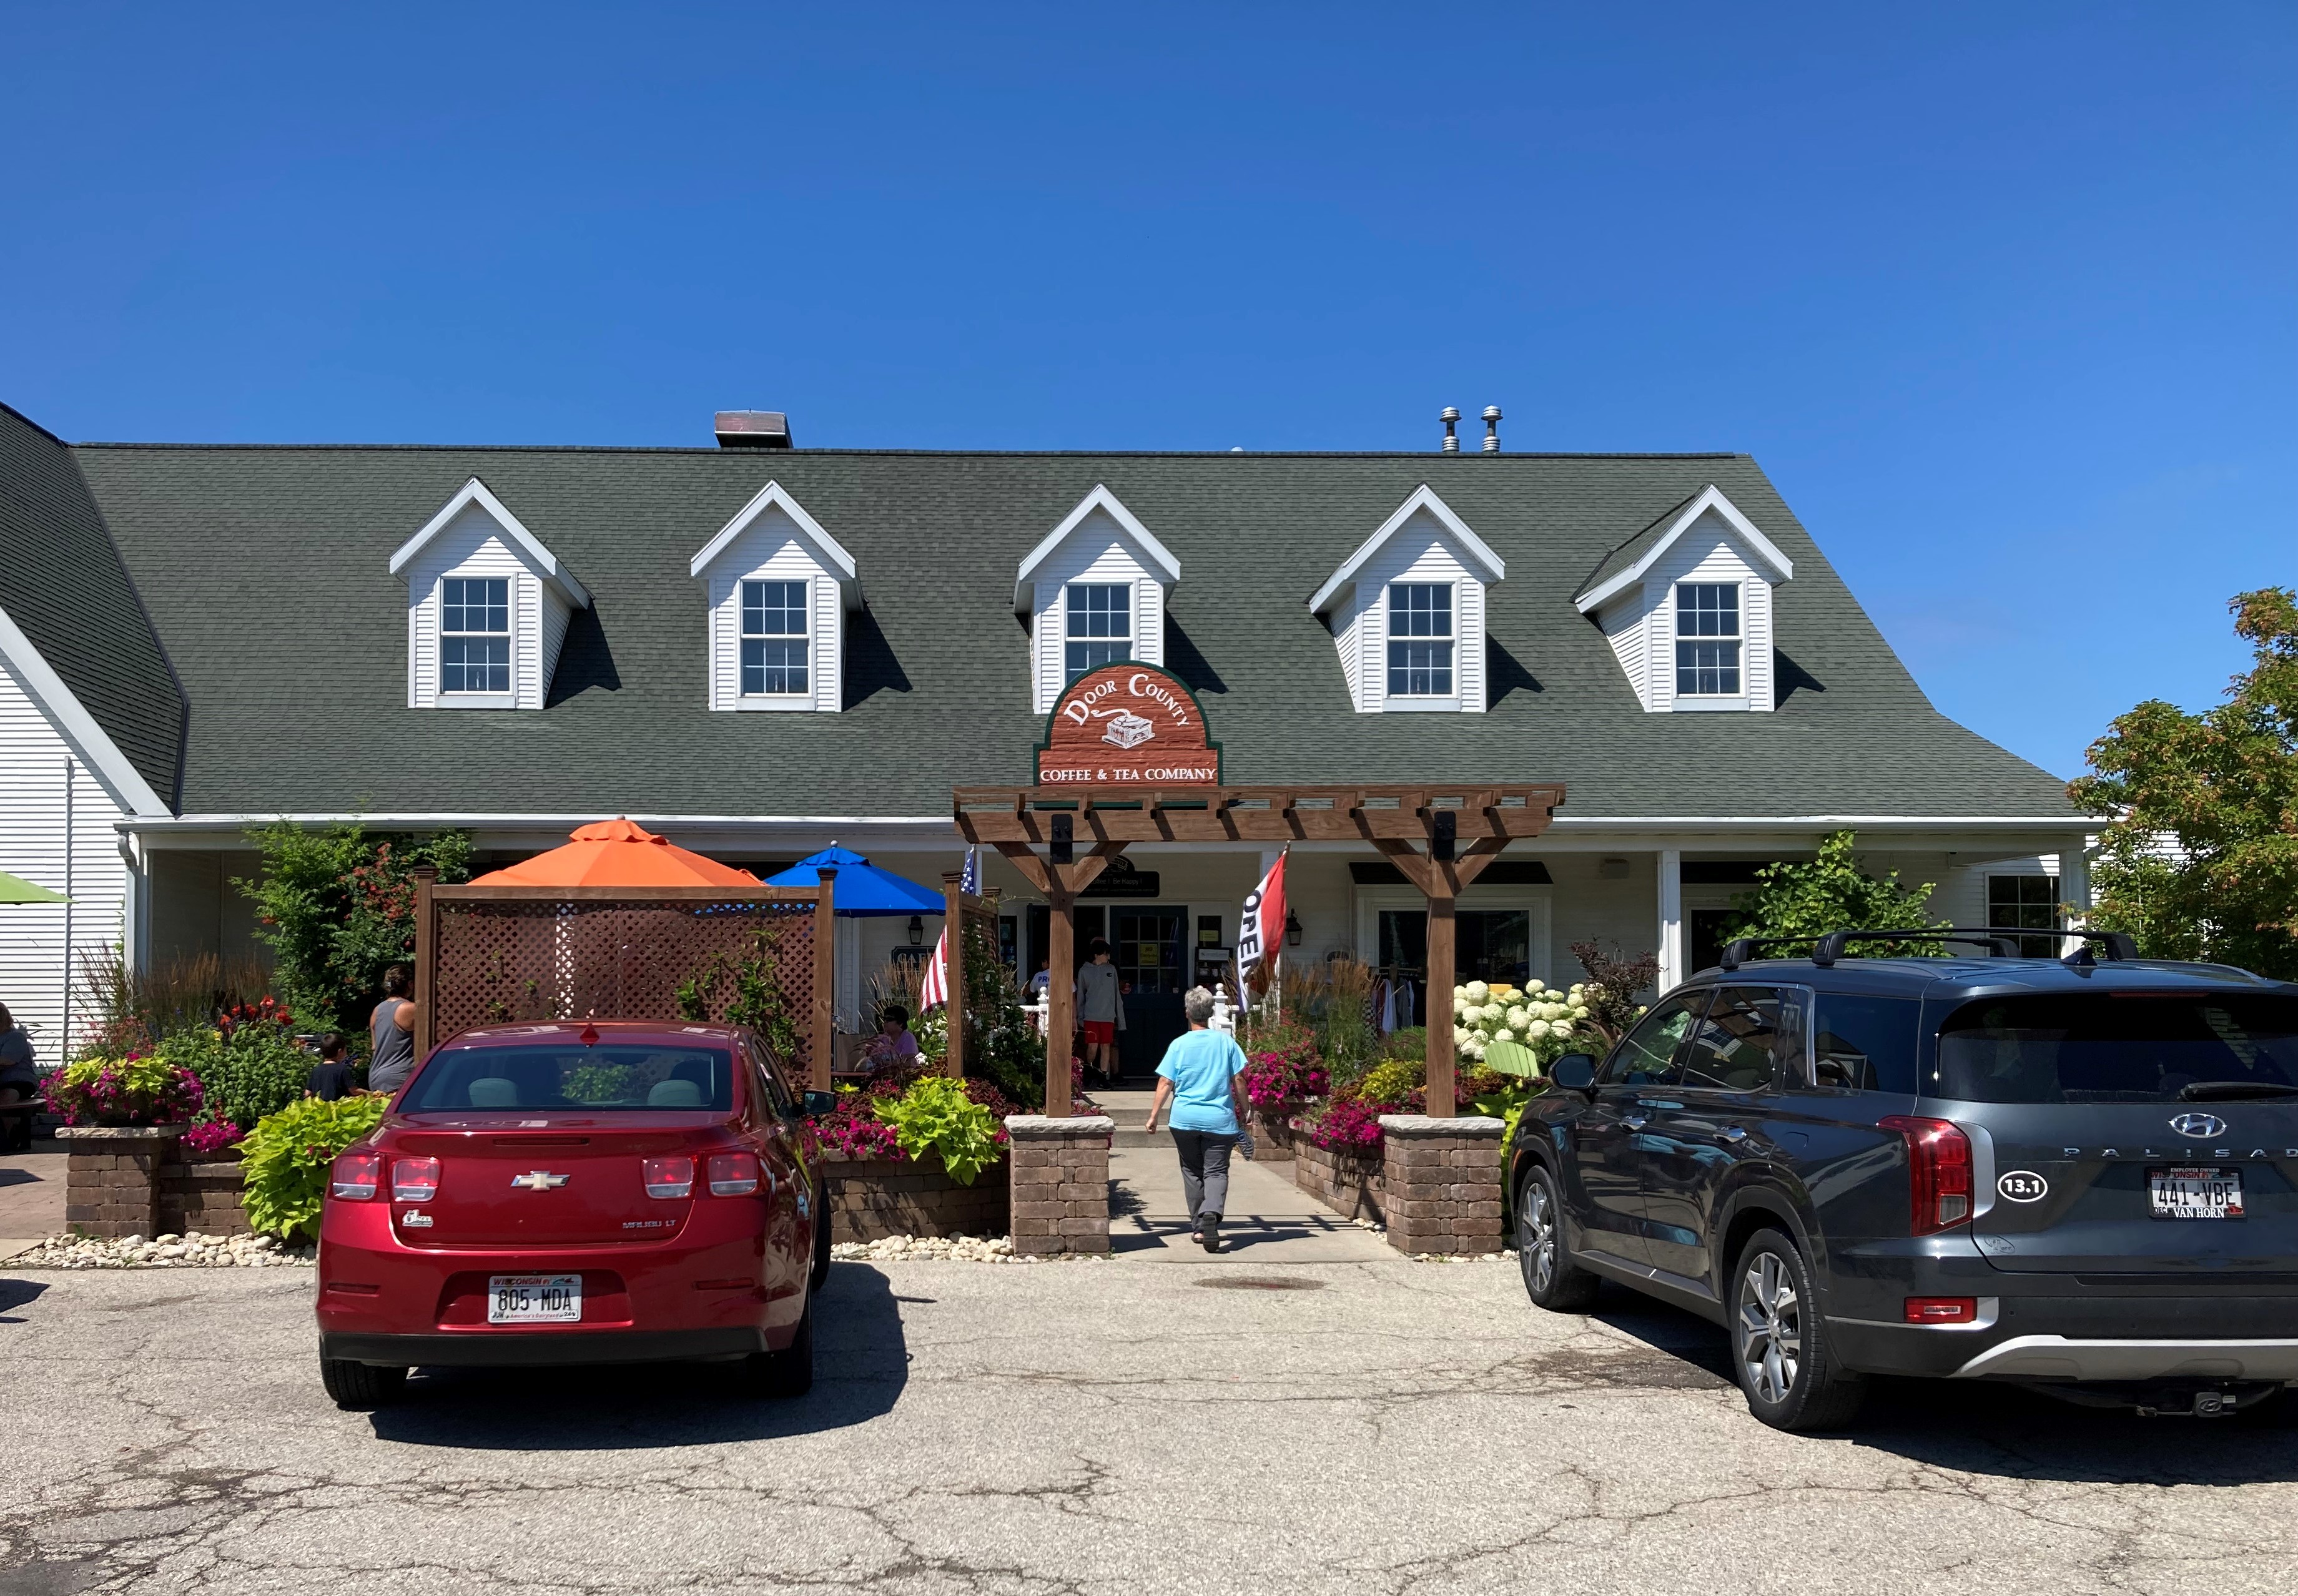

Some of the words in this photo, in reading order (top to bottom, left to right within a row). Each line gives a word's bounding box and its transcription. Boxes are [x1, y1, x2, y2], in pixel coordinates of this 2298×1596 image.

[1063, 680, 1118, 726] DOOR
[1128, 673, 1190, 727] COUNTY
[1040, 769, 1092, 782] COFFEE
[1097, 769, 1108, 781] &
[1113, 769, 1140, 781] TEA
[1145, 767, 1218, 781] COMPANY
[1122, 877, 1139, 885] Happy
[897, 953, 933, 963] CAF
[2005, 1179, 2039, 1193] 13.1
[2173, 1208, 2194, 1218] VAN
[2196, 1208, 2225, 1218] HORN
[493, 1278, 542, 1286] WISCONSIN
